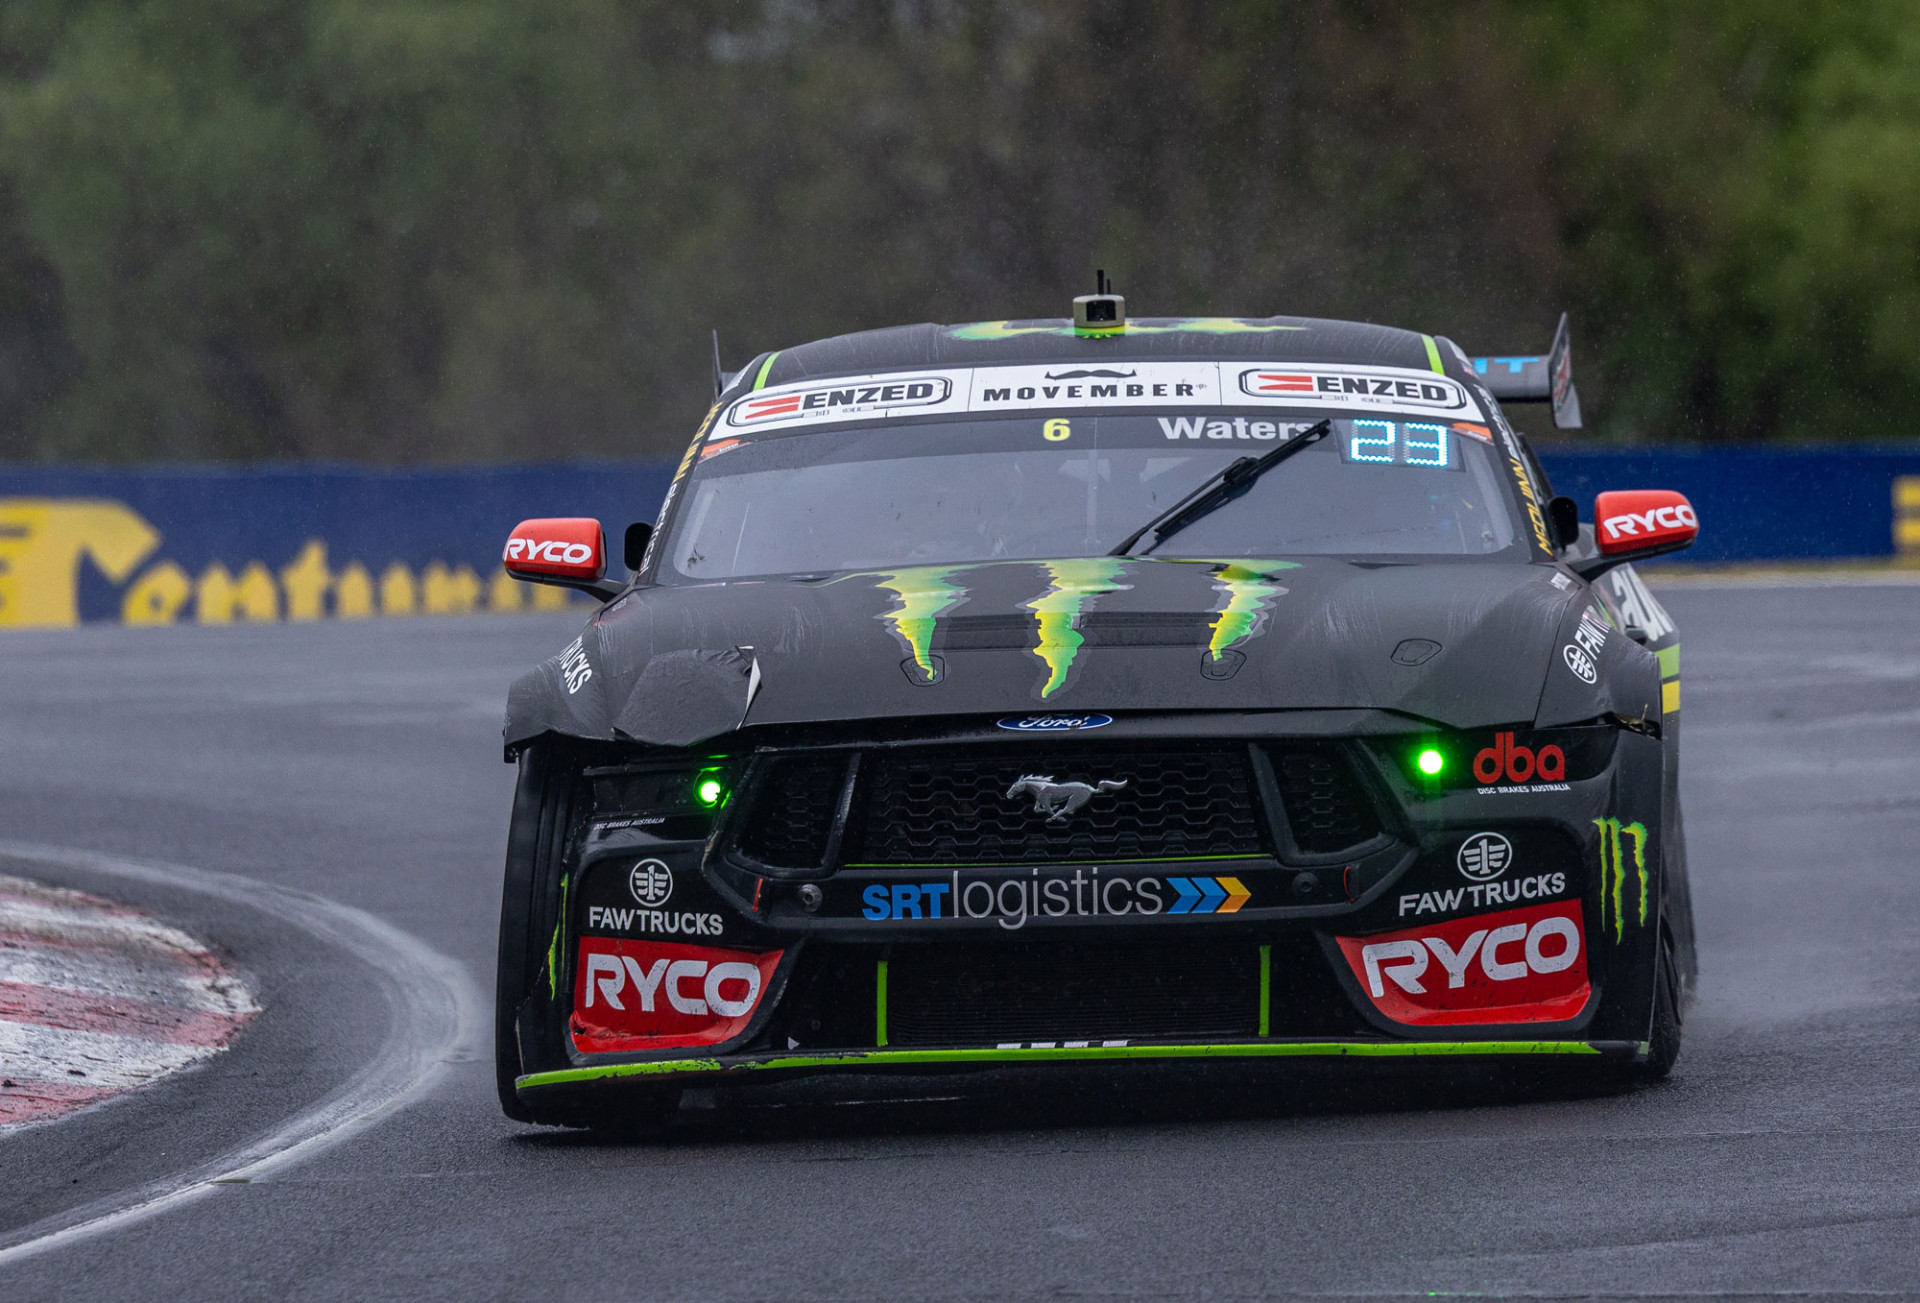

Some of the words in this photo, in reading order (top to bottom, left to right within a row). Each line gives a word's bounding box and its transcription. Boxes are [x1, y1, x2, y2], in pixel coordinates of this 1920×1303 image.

[802, 383, 934, 410] ENZED
[1317, 376, 1447, 401] ENZED
[1043, 418, 1071, 441] 6
[1351, 418, 1447, 467] 23
[1604, 504, 1697, 539] RYCO
[504, 538, 592, 564] RYCO
[1018, 713, 1091, 728] Ford
[1473, 731, 1565, 784] dba
[1477, 787, 1496, 795] DISC
[1497, 785, 1529, 794] BRAKES
[1531, 783, 1571, 793] AUSTRALIA
[630, 817, 665, 826] AUSTRALIA
[1361, 916, 1580, 999] RYCO
[585, 952, 761, 1018] RYCO
